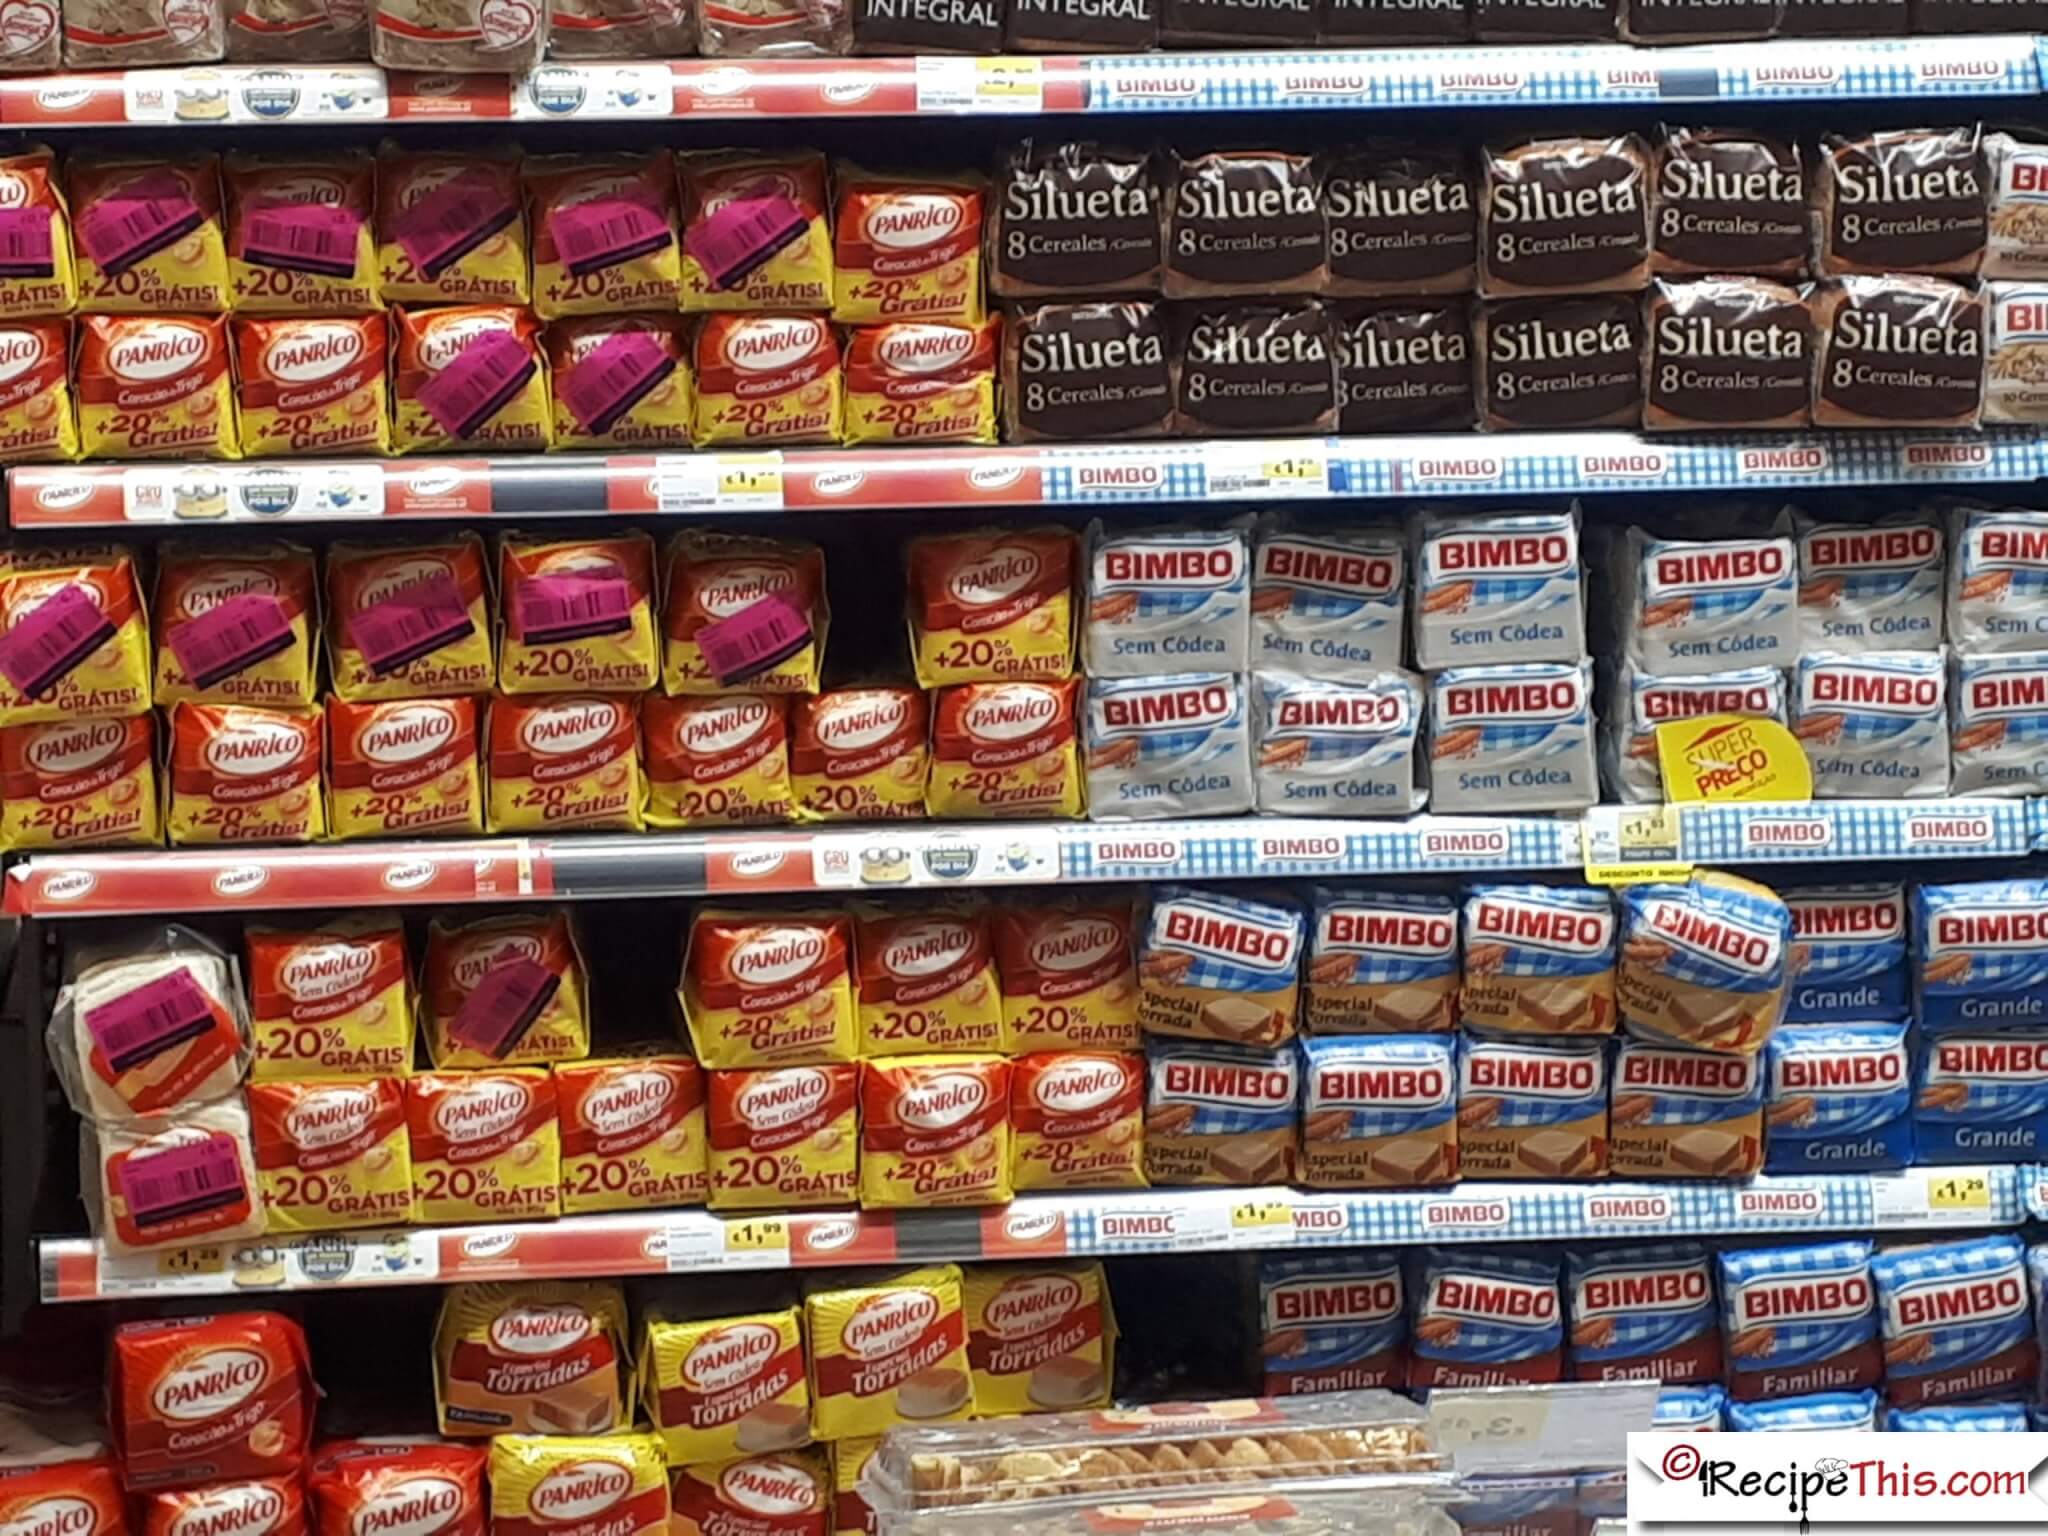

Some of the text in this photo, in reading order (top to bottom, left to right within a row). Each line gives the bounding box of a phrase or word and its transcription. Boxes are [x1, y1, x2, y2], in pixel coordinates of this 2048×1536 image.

[1662, 160, 1802, 202] Silueta
[1839, 164, 1980, 205] Silueta
[1004, 179, 1150, 221] Silueta
[1177, 179, 1315, 219] Silueta
[1327, 178, 1469, 218] Silueta
[1492, 182, 1636, 224] Silueta
[1662, 209, 1759, 236] 8 Cereales
[1864, 216, 1940, 236] Cereales
[1007, 230, 1025, 259] 8
[1030, 234, 1107, 252] Cereales
[1199, 232, 1277, 250] Cereales
[1331, 229, 1348, 256] 8
[1351, 231, 1427, 250] Cereales
[1497, 234, 1515, 263] 8
[1519, 234, 1595, 254] Cereales
[139, 280, 219, 303] GRÁTIS!
[747, 281, 823, 300] GRÁTIS!
[1187, 325, 1326, 365] Silueta
[1492, 321, 1632, 363] Silueta
[1659, 317, 1802, 359] Silueta
[1835, 313, 1979, 356] Silueta
[1021, 331, 1164, 373] Silueta
[1189, 374, 1286, 402] 8 Cereales
[1518, 372, 1595, 393] Cereales
[1661, 365, 1759, 392] 8 Cereales
[1833, 361, 1934, 387] 8 Cereales
[1027, 384, 1124, 411] 8 Cereales
[1351, 382, 1427, 399] Cereales
[1419, 459, 1498, 477] BIMBO
[1584, 455, 1661, 473] BIMBO
[1743, 447, 1821, 469] BIMBO
[1907, 446, 1985, 465] BIMBO
[1079, 467, 1158, 485] BIMBO
[1438, 535, 1570, 570] BIMBO
[1810, 529, 1937, 566] BIMBO
[1105, 550, 1234, 580] BIMBO
[1264, 547, 1393, 589] BIMBO
[1657, 547, 1782, 585] BIMBO
[1450, 622, 1563, 644] Sem Côdea
[1823, 616, 1931, 637] Sem Côdea
[1113, 634, 1225, 654] Sem Côdea
[1263, 633, 1372, 662] Sem Côdea
[1669, 633, 1778, 658] Sem Côdea
[59, 686, 137, 711] GRÁTIS!
[1446, 681, 1576, 715] BIMBO
[1643, 687, 1769, 719] BIMBO
[1813, 673, 1937, 705] BIMBO
[1104, 686, 1228, 727] BIMBO
[1278, 696, 1399, 726] BIMBO
[1686, 729, 1757, 775] SUPER
[1459, 768, 1571, 789] Sem Côdea
[1696, 749, 1768, 797] PREÇO
[1817, 758, 1920, 779] Sem Côdea
[1984, 765, 2029, 780] Sem
[1119, 775, 1231, 800] Sem Côdea
[1284, 779, 1397, 798] Sem Côdea
[1427, 834, 1502, 852] BIMBO
[1749, 824, 1825, 842] BIMBO
[1911, 820, 1987, 838] BIMBO
[1099, 841, 1175, 862] BIMBO
[1263, 838, 1339, 855] BIMBO
[1165, 911, 1288, 963] BIMBO
[1328, 915, 1452, 948] BIMBO
[1477, 905, 1601, 945] BIMBO
[1653, 902, 1769, 967] BIMBO
[1800, 986, 1880, 1009] Grande
[1960, 996, 2043, 1018] Grande
[1165, 1064, 1289, 1099] BIMBO
[1319, 1070, 1442, 1099] BIMBO
[1470, 1059, 1593, 1089] BIMBO
[1624, 1056, 1746, 1089] BIMBO
[1782, 1054, 1900, 1087] BIMBO
[1805, 1140, 1885, 1161] Grande
[1956, 1127, 2035, 1147] Grande
[1428, 1204, 1504, 1224] BIMBO
[1590, 1200, 1665, 1217] BIMBO
[1742, 1192, 1817, 1211] BIMBO
[1276, 1280, 1395, 1319] BIMBO
[1436, 1279, 1554, 1318] BIMBO
[1585, 1271, 1706, 1308] BIMBO
[1744, 1278, 1867, 1318] BIMBO
[1899, 1277, 2020, 1325] BIMBO
[989, 1321, 1086, 1374] Torradas
[486, 1354, 590, 1392] Torradas
[852, 1332, 948, 1395] Torradas
[1292, 1369, 1386, 1394] Familiar
[1763, 1367, 1857, 1393] Familiar
[1922, 1367, 2016, 1398] Familiar
[691, 1371, 789, 1426] Torradas
